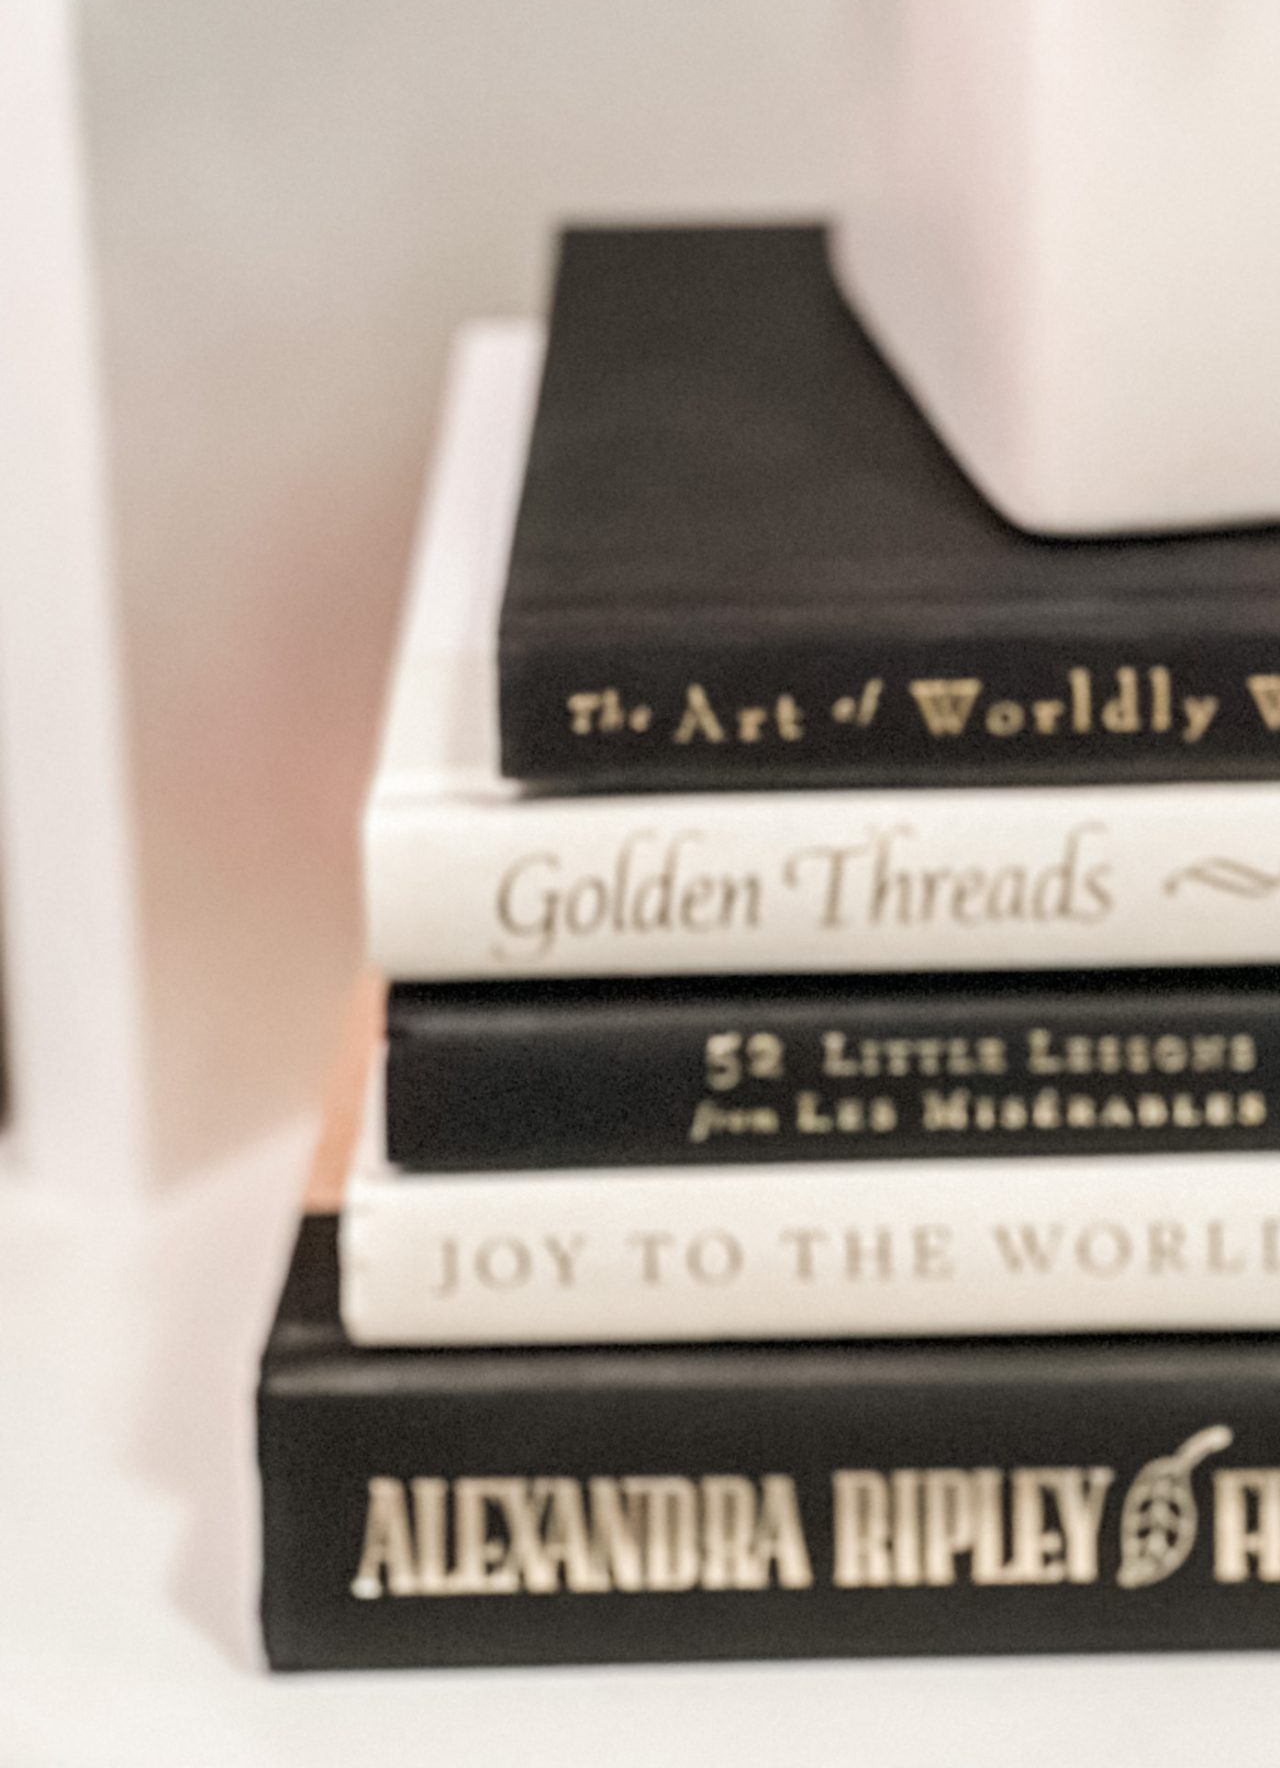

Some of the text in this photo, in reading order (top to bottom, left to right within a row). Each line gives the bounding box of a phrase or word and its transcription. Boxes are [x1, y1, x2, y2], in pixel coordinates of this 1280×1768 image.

[567, 689, 651, 734] The
[675, 684, 802, 743] Art
[832, 678, 883, 725] of
[909, 666, 1218, 742] Worldly
[493, 821, 1114, 966] Golden Threads
[706, 1030, 783, 1089] 52
[438, 1234, 585, 1298] JOY
[627, 1230, 745, 1287] TO
[782, 1225, 956, 1283] THE
[351, 1467, 1113, 1599] ALEXANDRA RIPLEY
